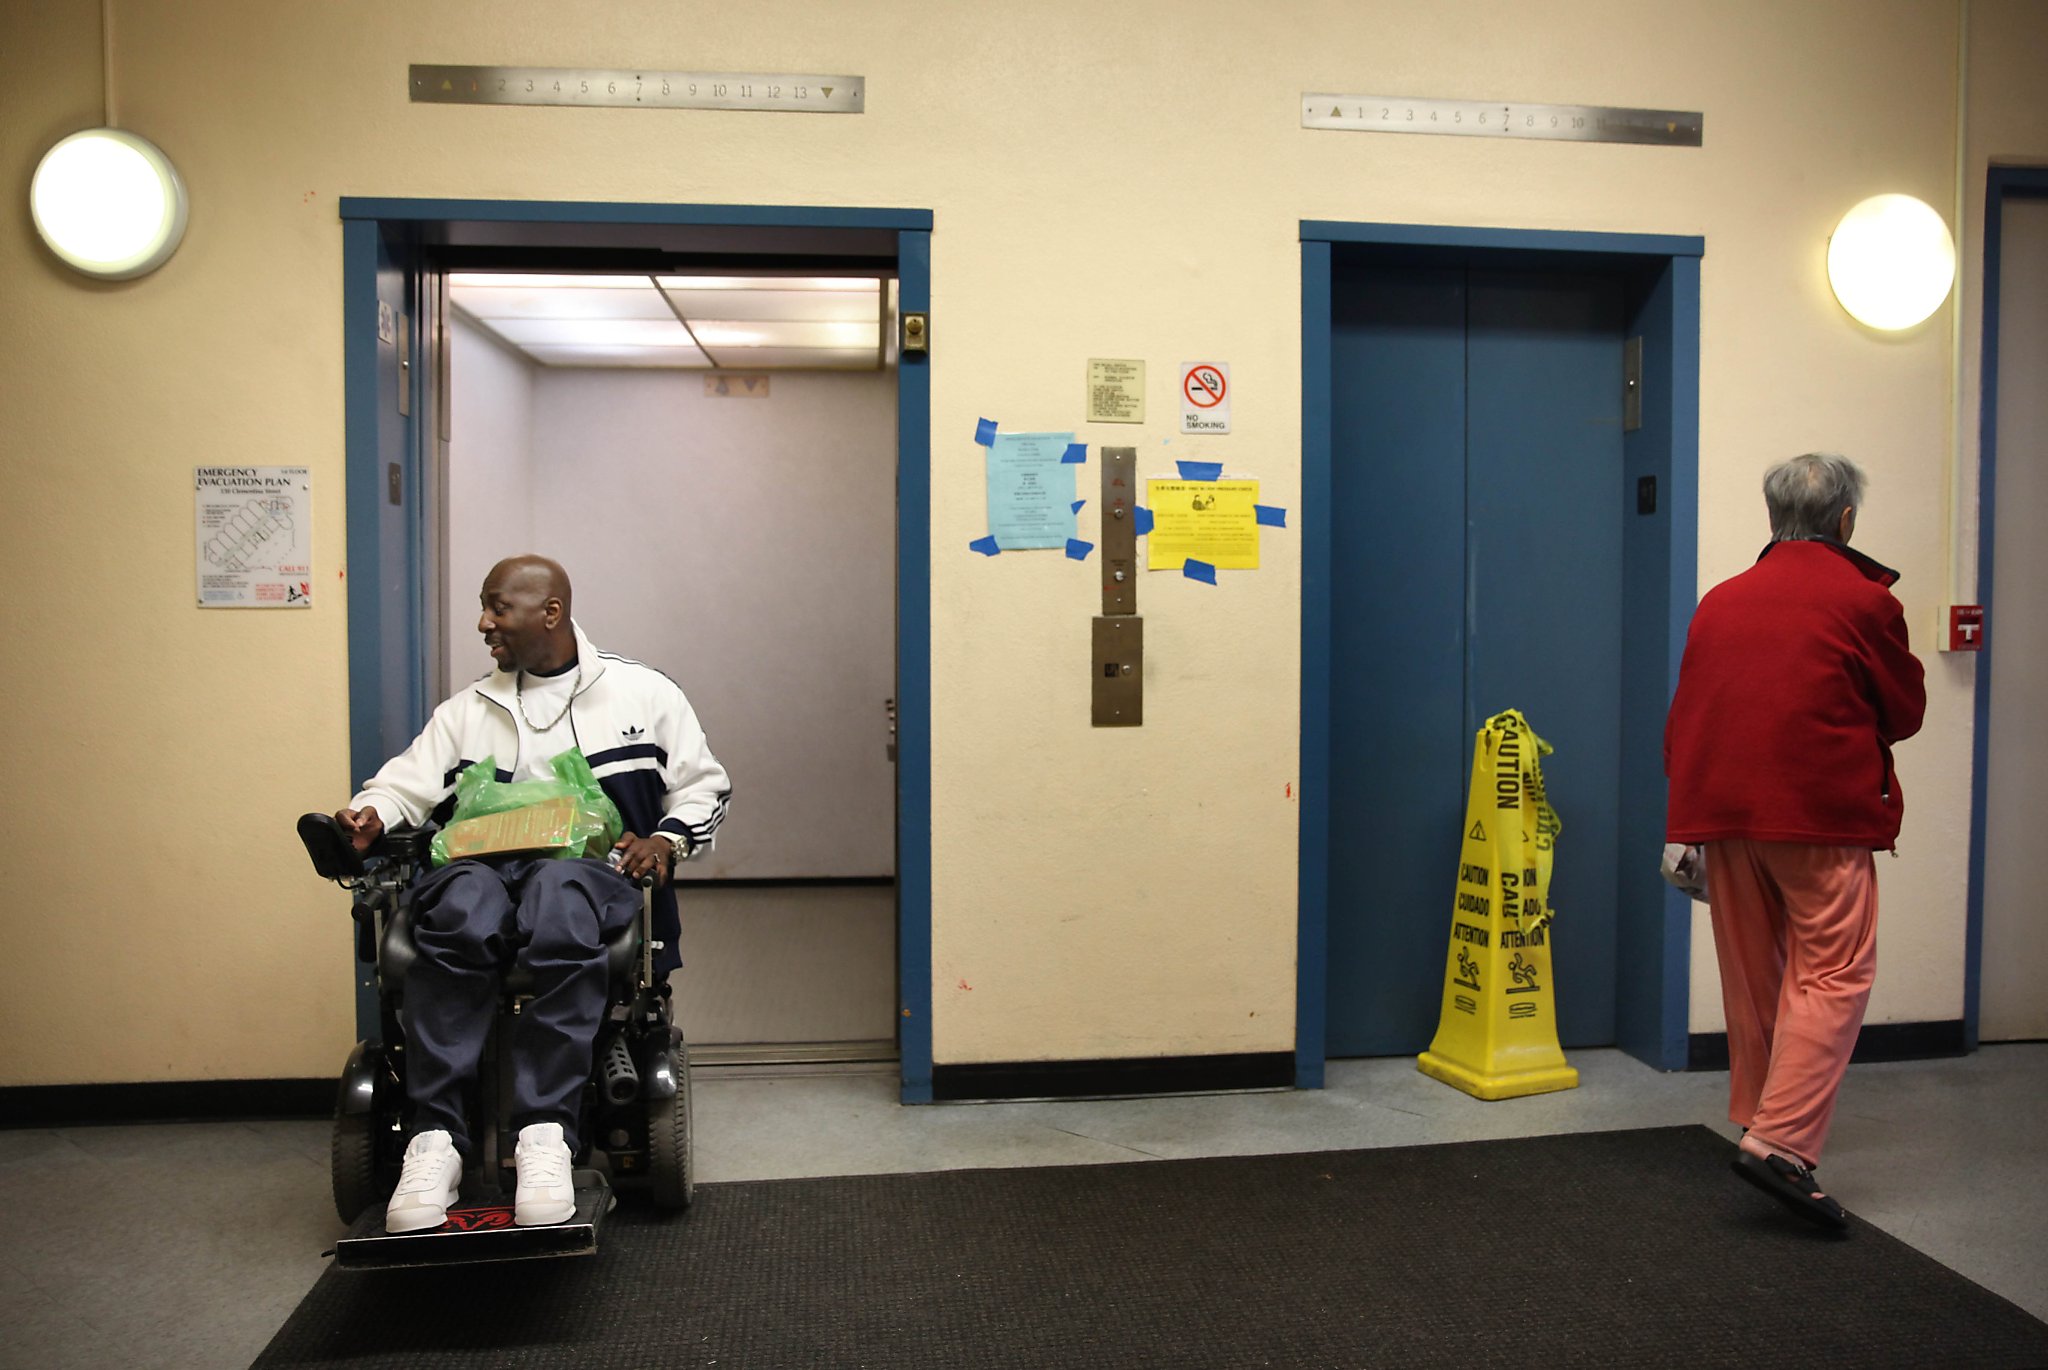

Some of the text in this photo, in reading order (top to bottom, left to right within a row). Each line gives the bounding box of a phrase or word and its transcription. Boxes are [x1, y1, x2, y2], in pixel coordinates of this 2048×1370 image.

[498, 79, 506, 92] 2
[525, 80, 534, 92] 3
[553, 80, 561, 93] 4
[580, 81, 589, 93] 5
[607, 82, 616, 94] 6
[635, 82, 642, 95] 7
[661, 82, 670, 96] 8
[689, 83, 697, 96] 9
[713, 84, 727, 97] 10
[741, 85, 752, 98] 11
[767, 86, 780, 98] 12
[794, 86, 807, 99] 13
[1381, 107, 1389, 120] 2
[1406, 108, 1414, 121] 3
[1430, 110, 1438, 122] 4
[1454, 111, 1462, 123] 5
[1478, 112, 1486, 124] 6
[1503, 114, 1510, 126] 7
[1526, 115, 1534, 127] 8
[1550, 116, 1558, 128] 9
[1571, 117, 1584, 129] 10
[197, 468, 257, 477] EMERGENCY
[198, 478, 291, 487] EVACUATION PLAN
[1496, 714, 1520, 809] CAUTION
[1461, 863, 1489, 887] CAUTION
[1459, 892, 1490, 917] CUIDADO
[1454, 922, 1489, 948] ATTENTION
[1500, 926, 1545, 949] ATTENTION
